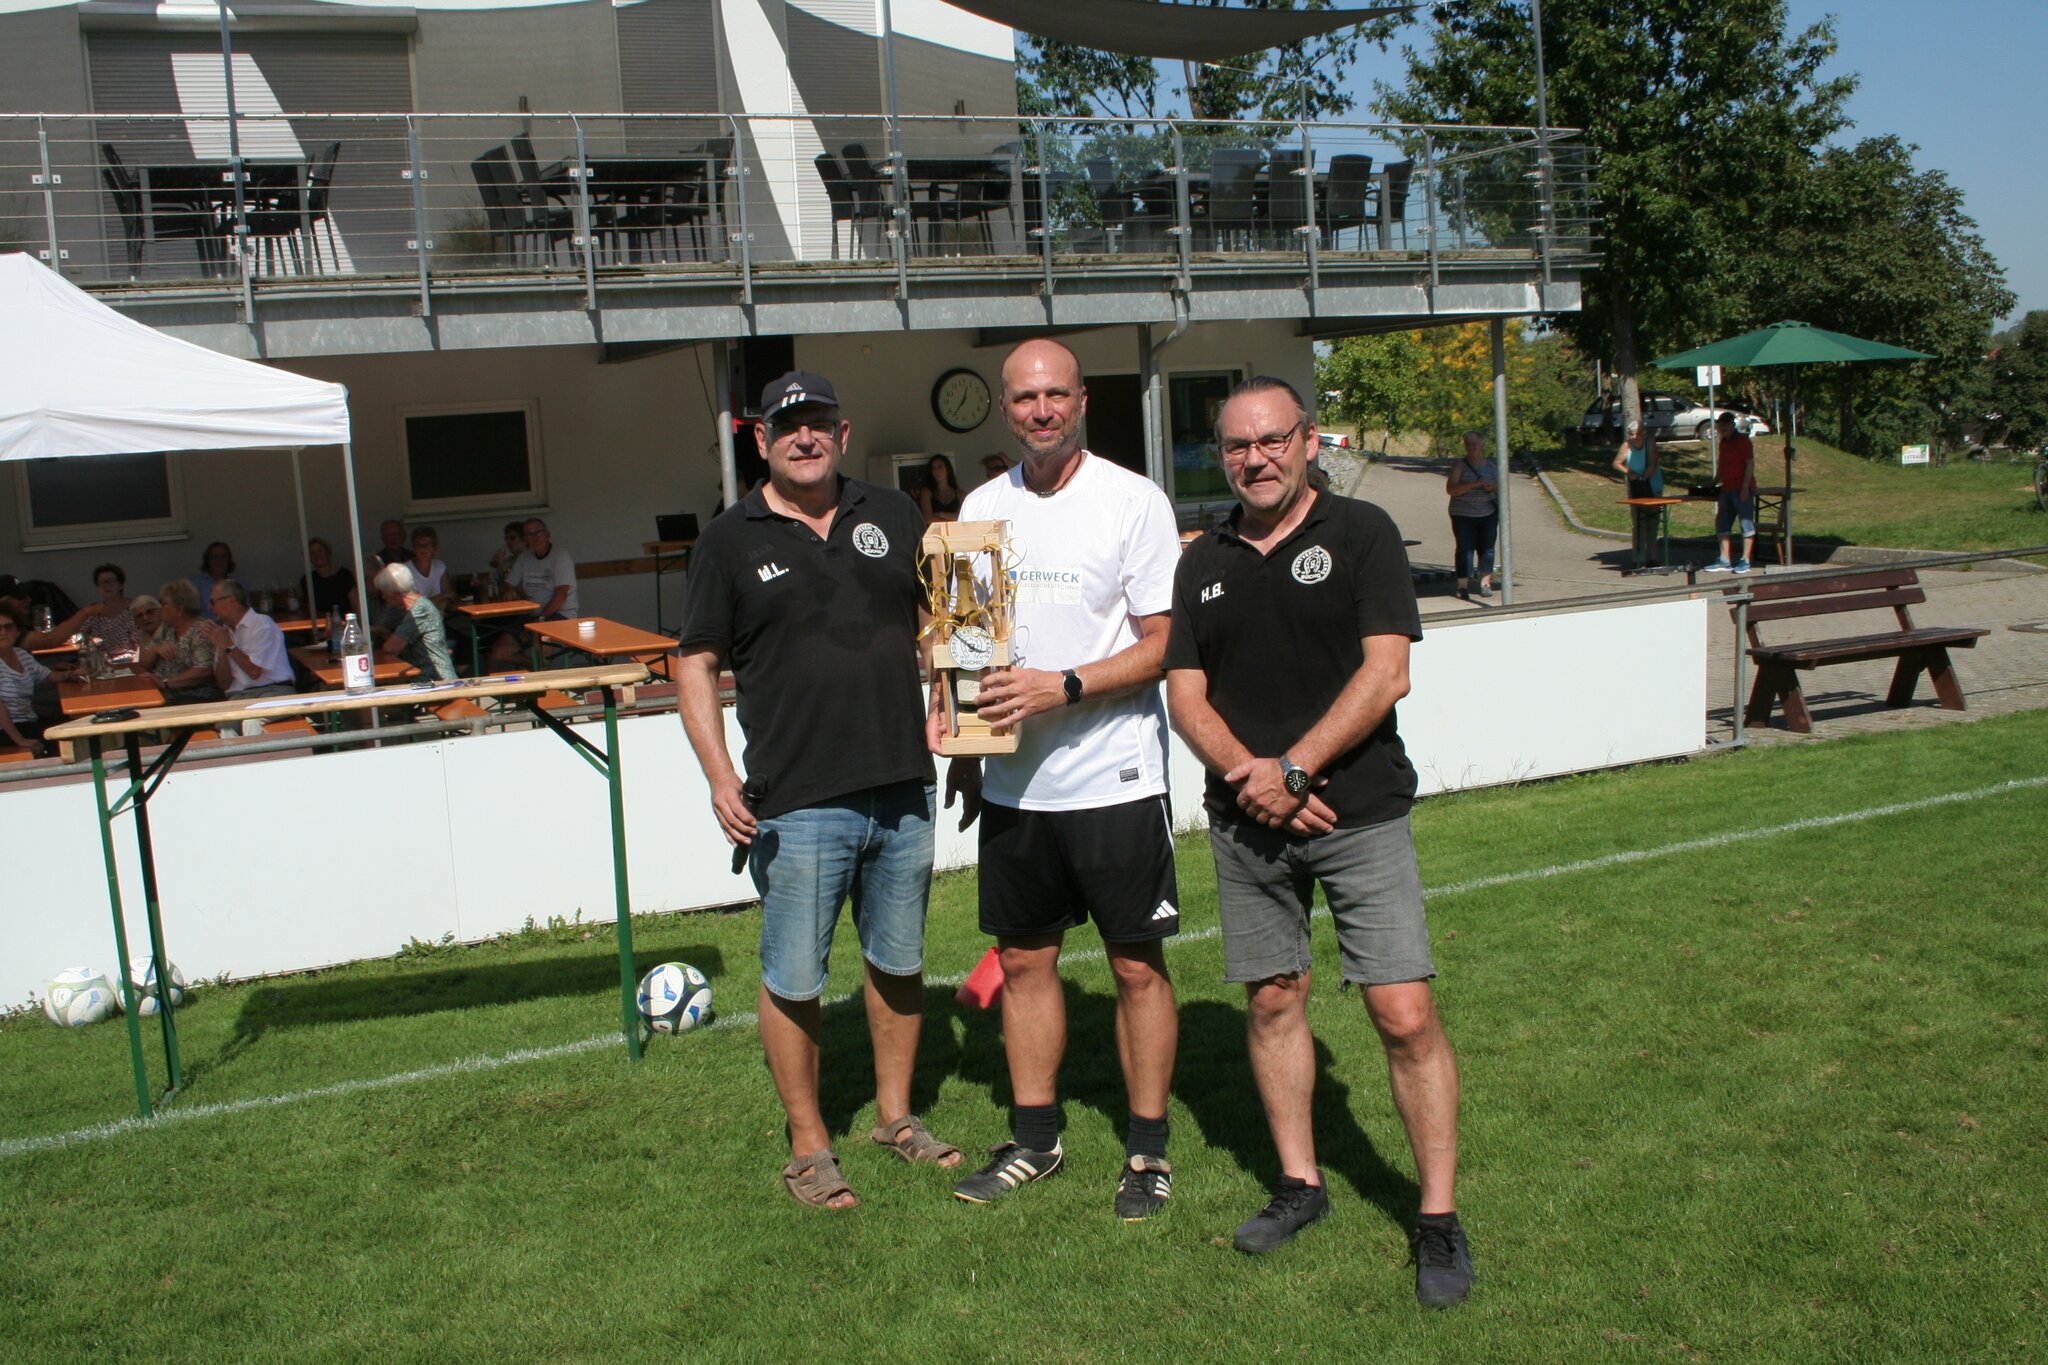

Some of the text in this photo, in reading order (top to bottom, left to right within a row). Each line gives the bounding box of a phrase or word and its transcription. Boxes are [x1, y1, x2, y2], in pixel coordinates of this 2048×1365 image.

[757, 562, 789, 582] W.L.
[1020, 570, 1080, 583] GERWECK
[1201, 582, 1224, 603] H.B.
